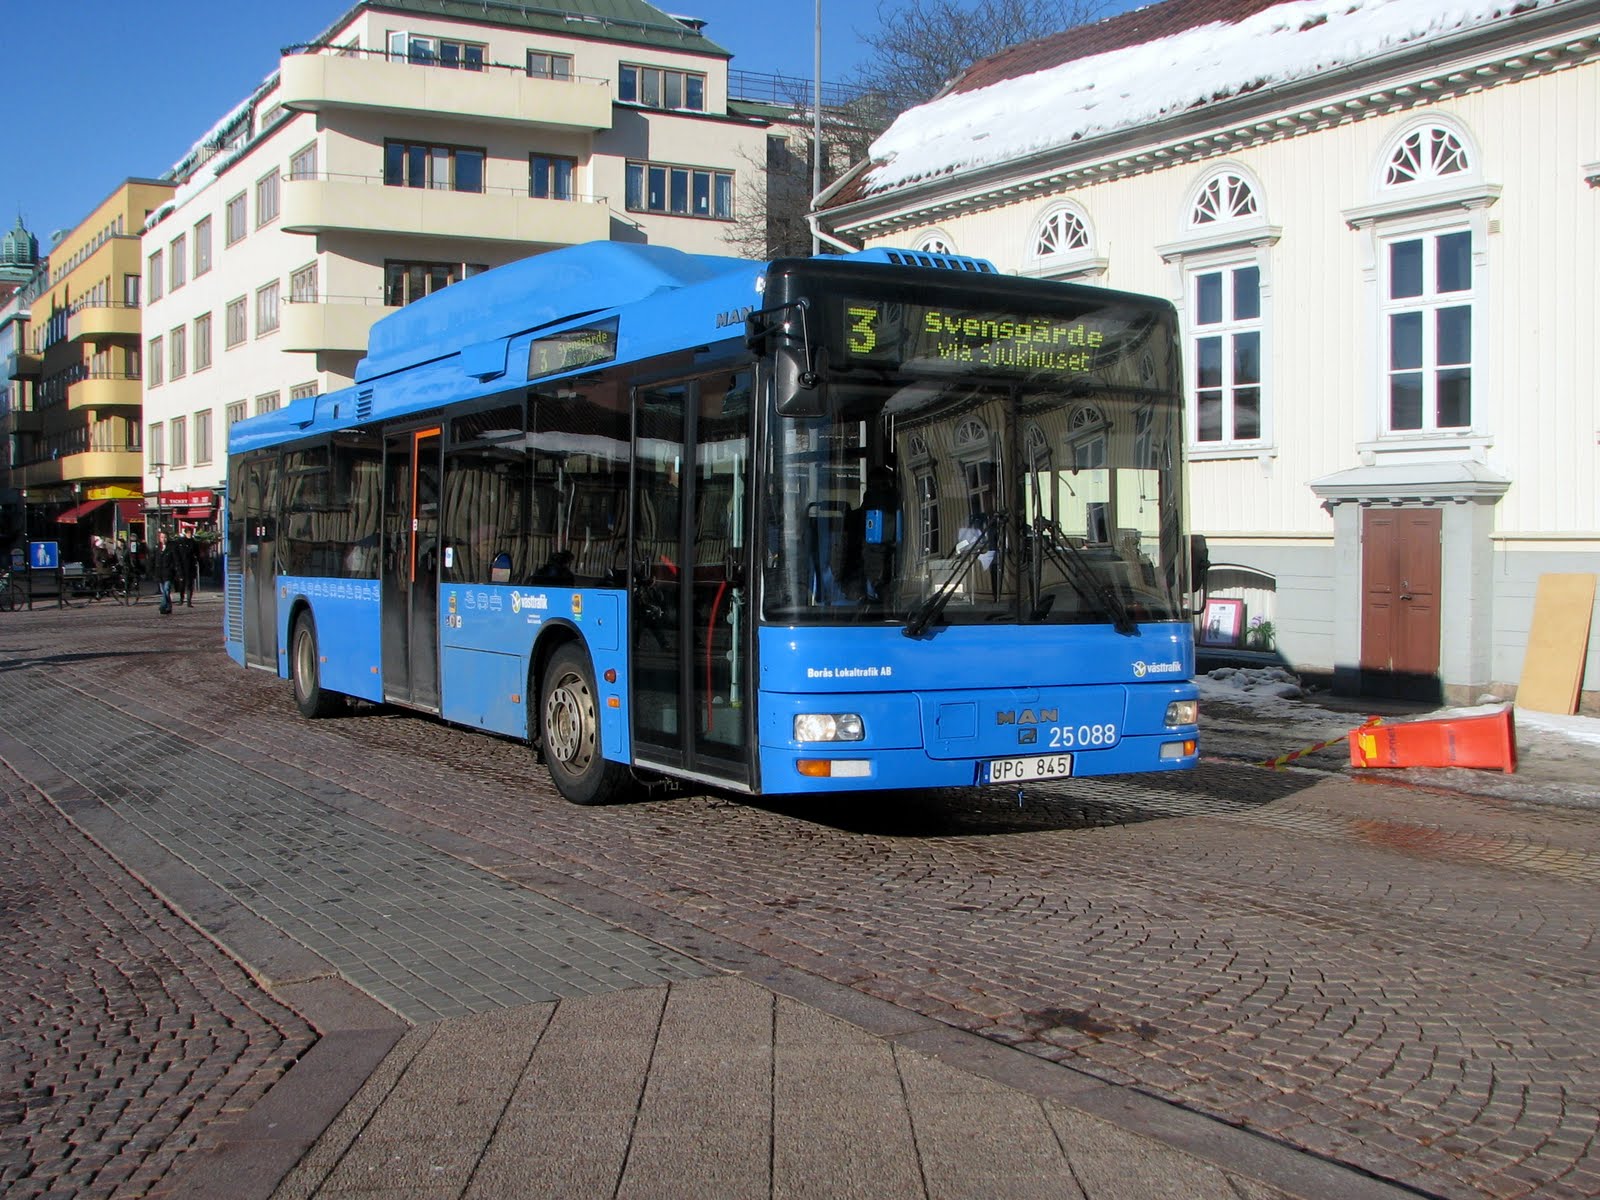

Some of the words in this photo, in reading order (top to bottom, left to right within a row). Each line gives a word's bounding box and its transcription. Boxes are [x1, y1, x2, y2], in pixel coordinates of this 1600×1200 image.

[716, 305, 754, 329] MAN
[848, 307, 877, 354] 3
[925, 311, 1103, 348] Svensgärde
[937, 337, 973, 361] via
[980, 341, 1090, 372] Sjukhuset
[807, 667, 833, 678] Borås
[834, 667, 879, 678] Lokaltrafik
[880, 666, 892, 677] AB
[1147, 661, 1182, 673] västtrafik
[996, 708, 1059, 725] MAN
[993, 761, 1024, 780] UPG
[1036, 757, 1068, 776] 845
